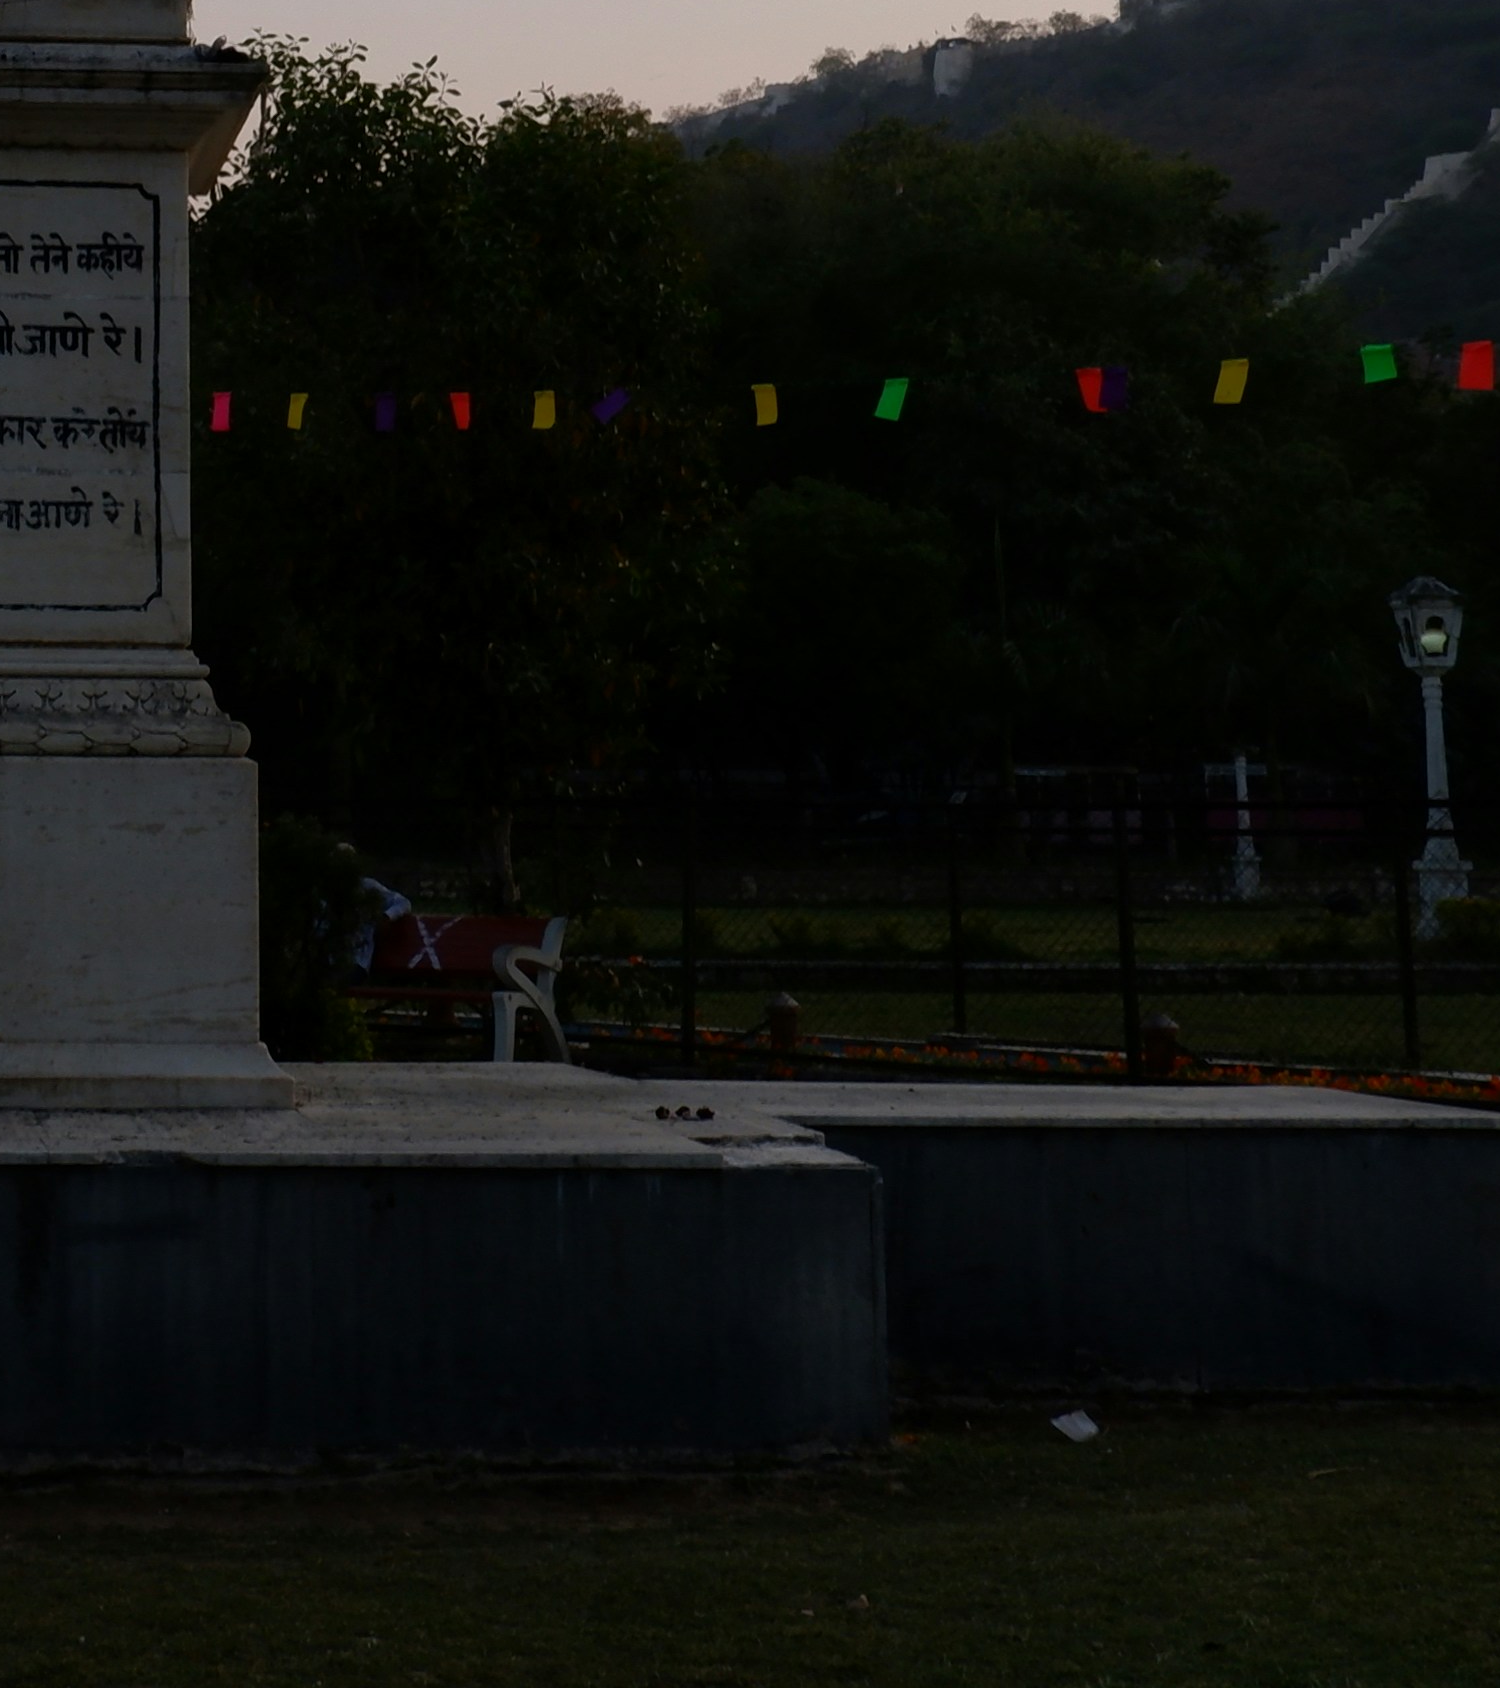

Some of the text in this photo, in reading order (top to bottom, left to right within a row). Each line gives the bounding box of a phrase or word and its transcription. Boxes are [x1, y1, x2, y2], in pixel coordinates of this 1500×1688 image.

[30, 232, 72, 274] तेने
[77, 232, 144, 280] कहीये
[15, 311, 94, 358] जाणे
